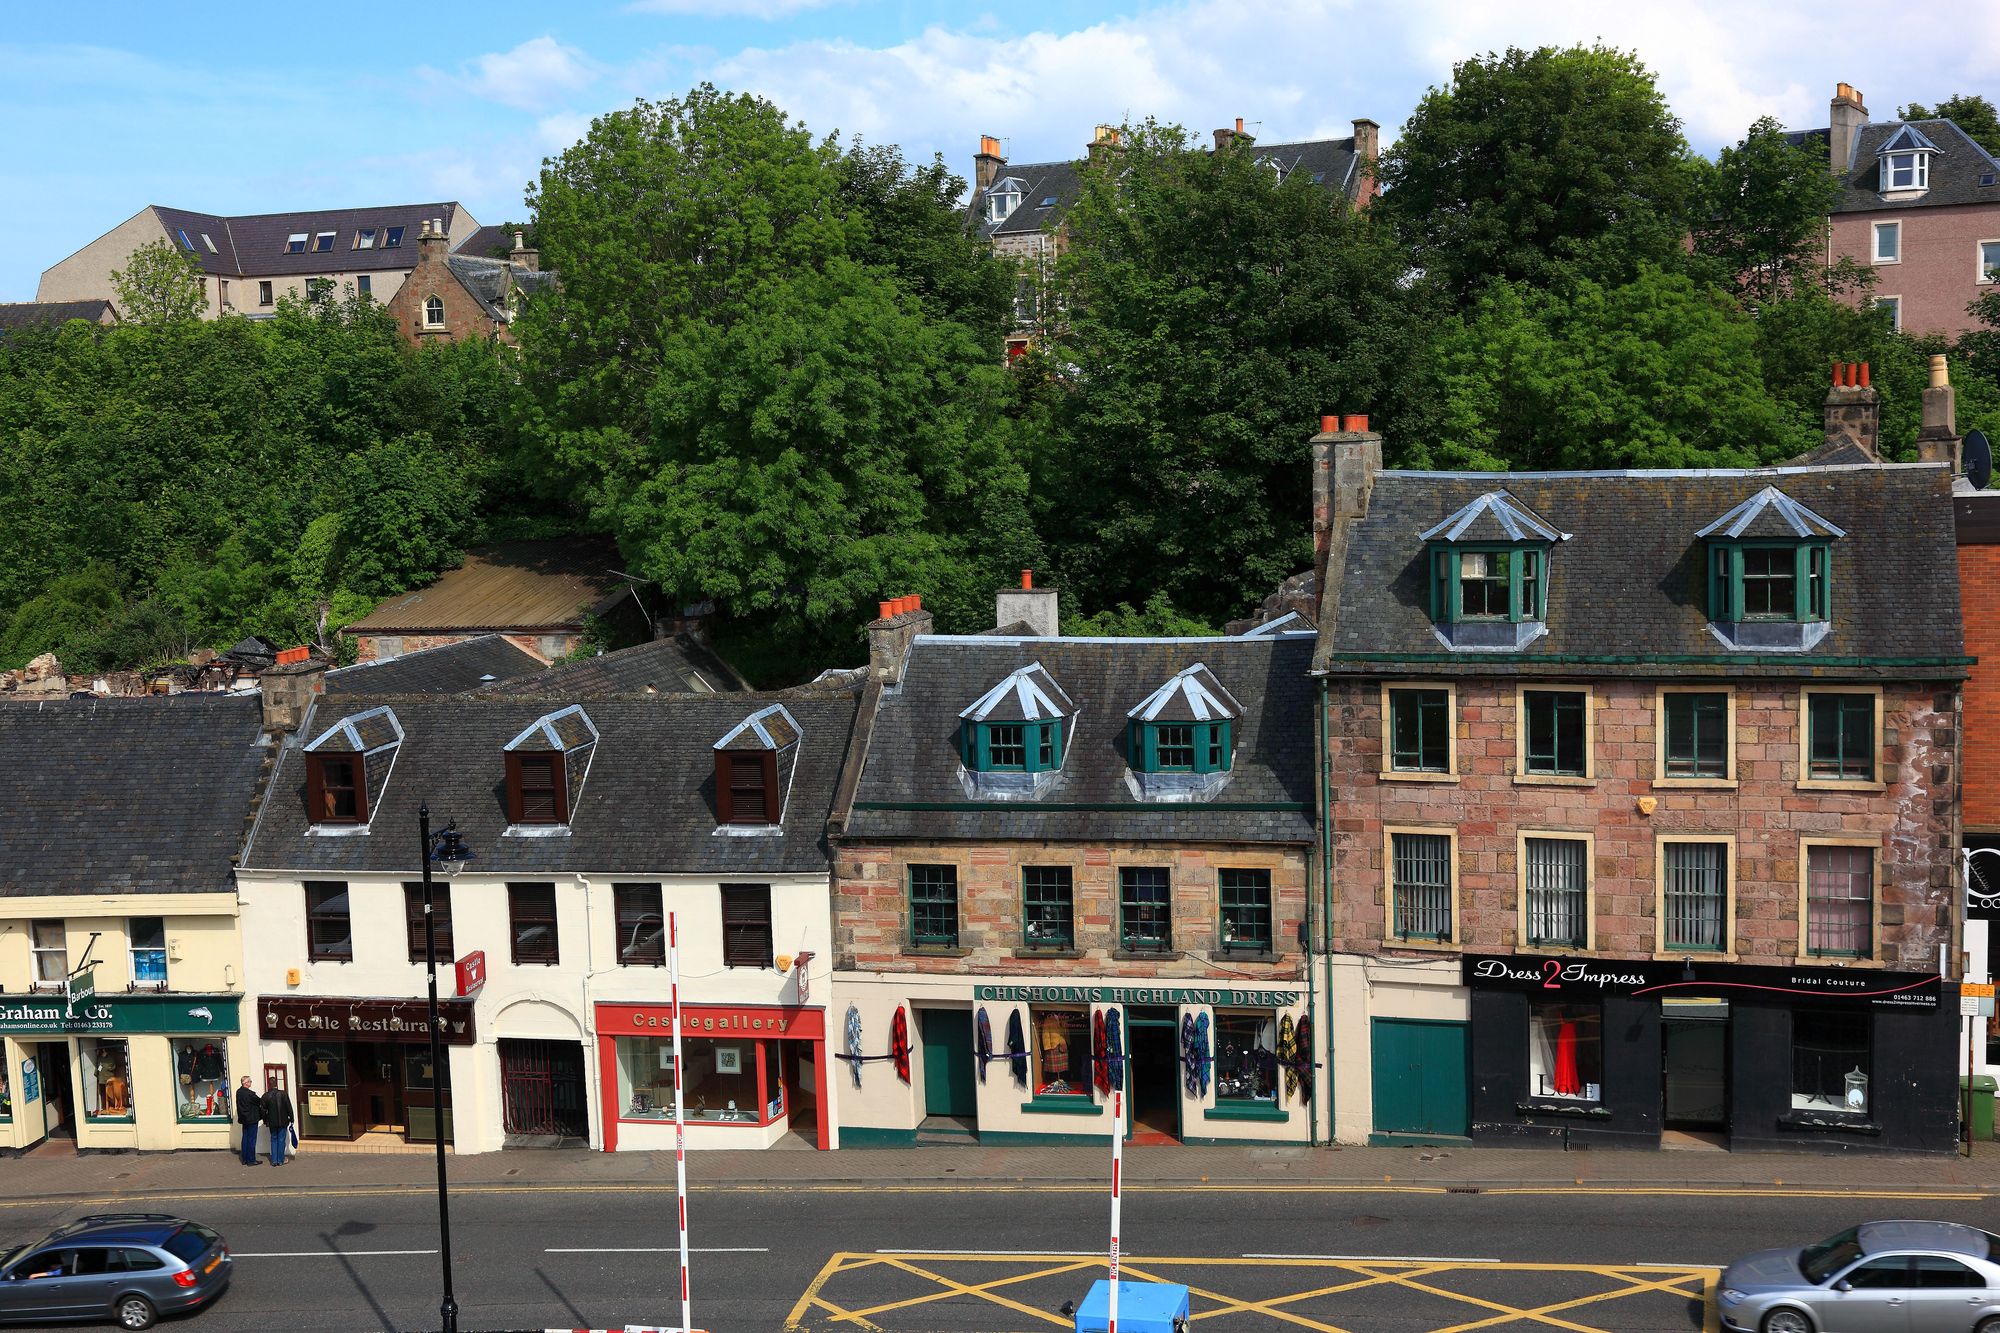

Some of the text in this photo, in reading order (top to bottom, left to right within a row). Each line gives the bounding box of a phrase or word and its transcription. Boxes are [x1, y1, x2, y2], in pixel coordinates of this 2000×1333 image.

[1473, 959, 1646, 989] Dress 2 Impress
[1791, 977, 1866, 987] Bridal Couture
[71, 986, 94, 1003] Barbour
[981, 986, 1297, 1006] CHISHOLMS HIGHLAND DRESS
[632, 1012, 788, 1032] Caslegallery
